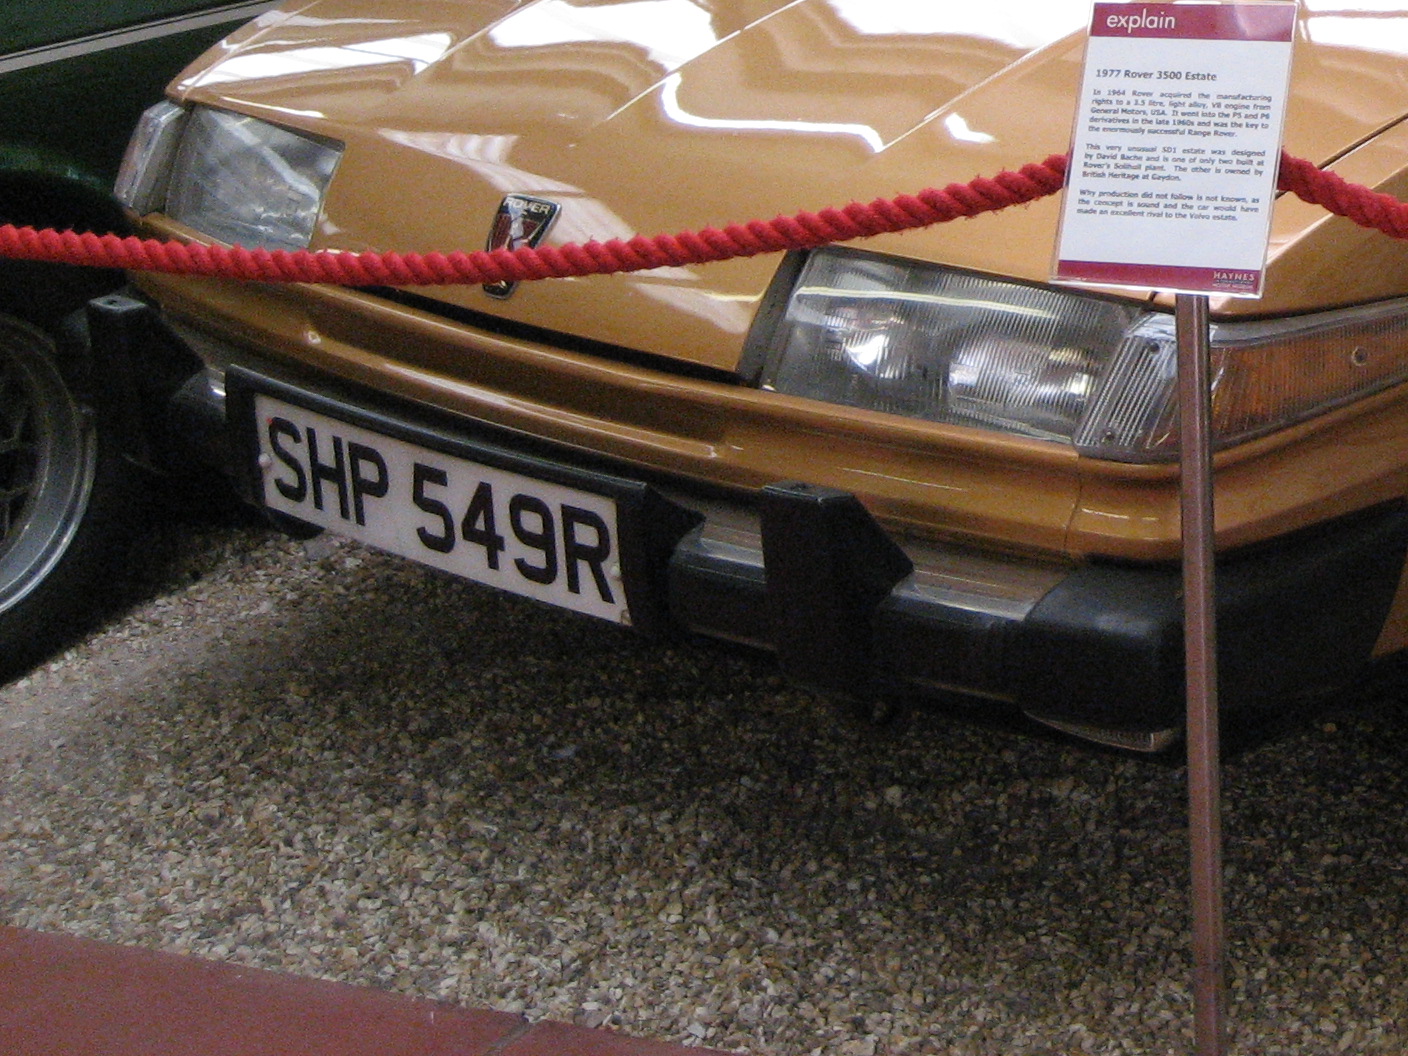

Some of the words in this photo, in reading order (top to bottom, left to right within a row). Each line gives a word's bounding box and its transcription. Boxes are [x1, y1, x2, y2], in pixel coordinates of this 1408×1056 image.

[1106, 7, 1175, 34] explain
[1096, 69, 1121, 78] 1977
[1124, 70, 1153, 78] Rover
[1156, 71, 1182, 80] 3500
[1185, 72, 1217, 81] Estate
[502, 196, 550, 214] ROVER
[1213, 271, 1254, 280] HAYNES
[268, 416, 389, 526] SHP
[412, 462, 615, 604] 549R
